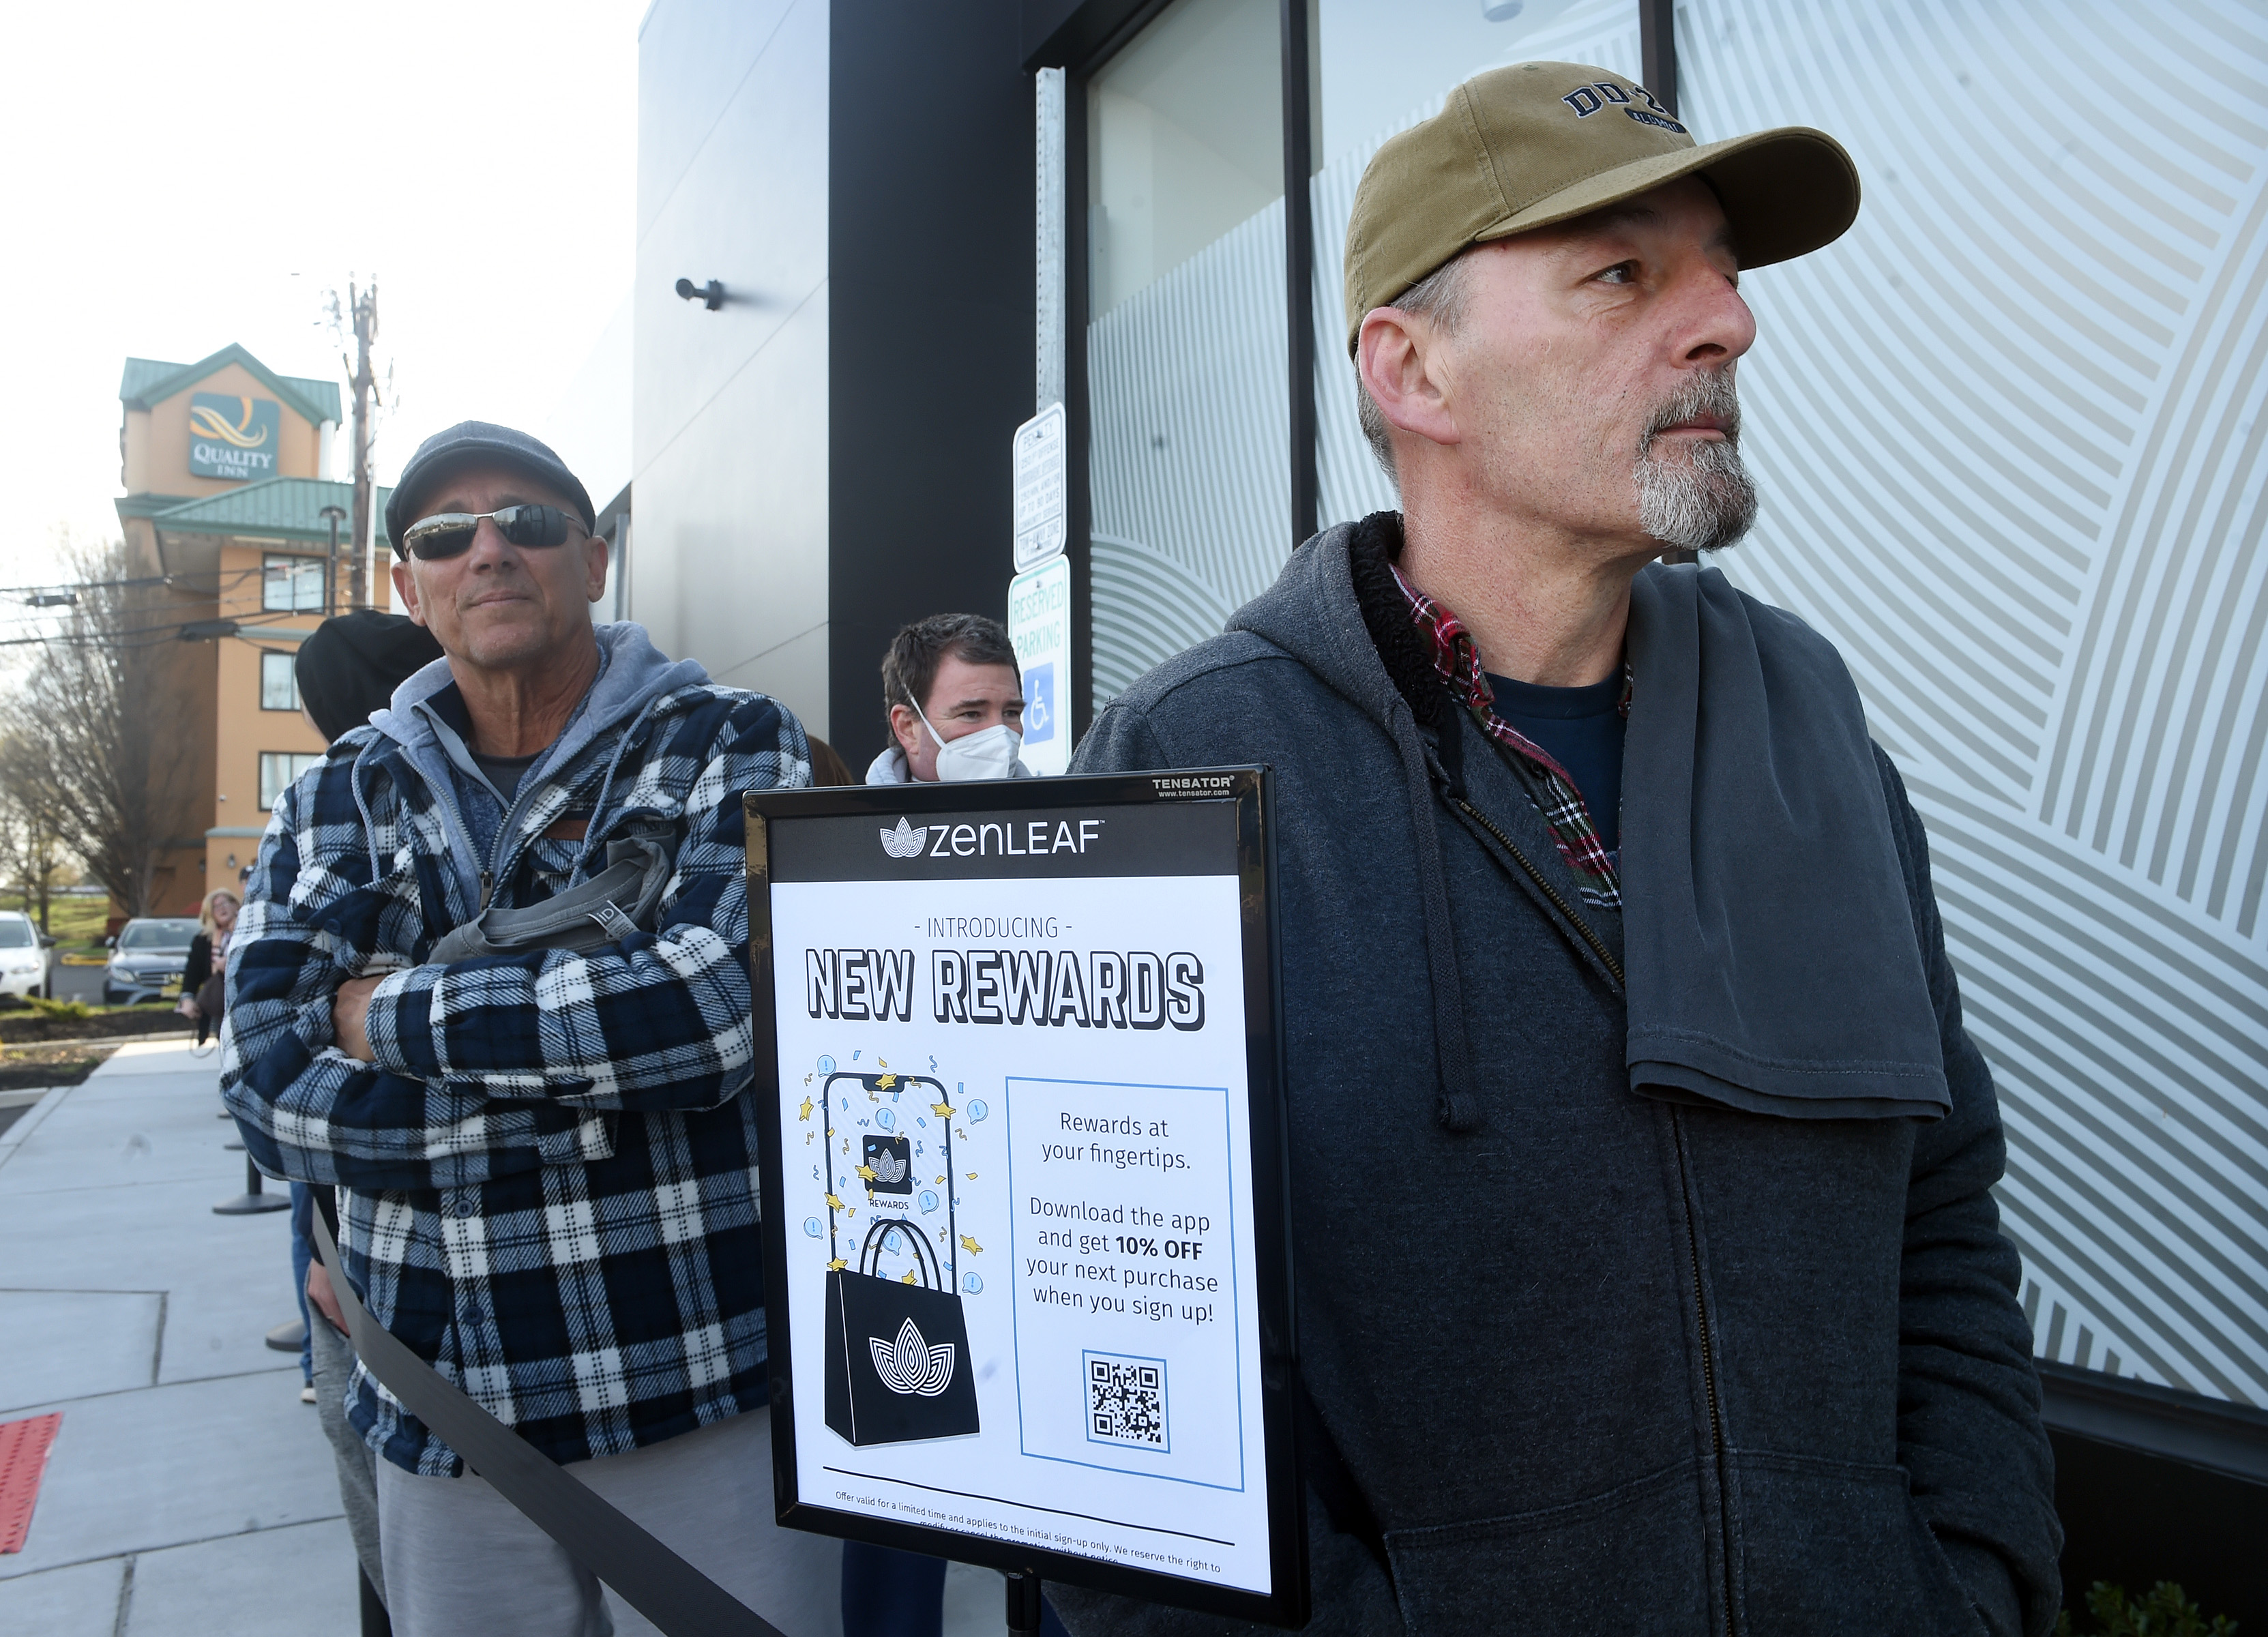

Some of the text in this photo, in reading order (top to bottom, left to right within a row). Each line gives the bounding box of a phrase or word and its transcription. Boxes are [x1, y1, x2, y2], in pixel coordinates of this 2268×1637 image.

[1633, 112, 1680, 133] ALUMNI
[1023, 419, 1055, 448] PENTY
[194, 443, 273, 469] QUALITY
[218, 464, 248, 477] INN
[1014, 580, 1063, 625] RESERVED
[1016, 621, 1060, 661] PARKING
[928, 917, 1058, 938] INTRODUCING
[806, 948, 1205, 1032] NEW REWARDS
[1061, 1112, 1169, 1138] Rewards at
[1042, 1142, 1190, 1173] your fingertips.
[870, 1199, 909, 1210] REWARDS
[1031, 1196, 1210, 1236] Download the app
[1038, 1228, 1203, 1260] and get 10% OFF
[1026, 1258, 1218, 1293] your next purchase
[1033, 1284, 1213, 1326] when you sign up!
[836, 1491, 854, 1502] Offer
[856, 1496, 875, 1506] valid
[878, 1499, 889, 1508] for
[898, 1502, 926, 1516] limited
[928, 1509, 946, 1520] time
[949, 1514, 964, 1523] and
[967, 1517, 997, 1530] applies
[999, 1523, 1008, 1532] to
[1010, 1525, 1024, 1535] the
[1027, 1527, 1052, 1541] initial
[1055, 1533, 1087, 1548] sign-up
[1091, 1542, 1112, 1553] only.
[1114, 1545, 1128, 1555] We
[1131, 1550, 1165, 1562] reserve
[1168, 1555, 1183, 1565] the
[1186, 1558, 1208, 1570] right
[1211, 1564, 1220, 1573] to
